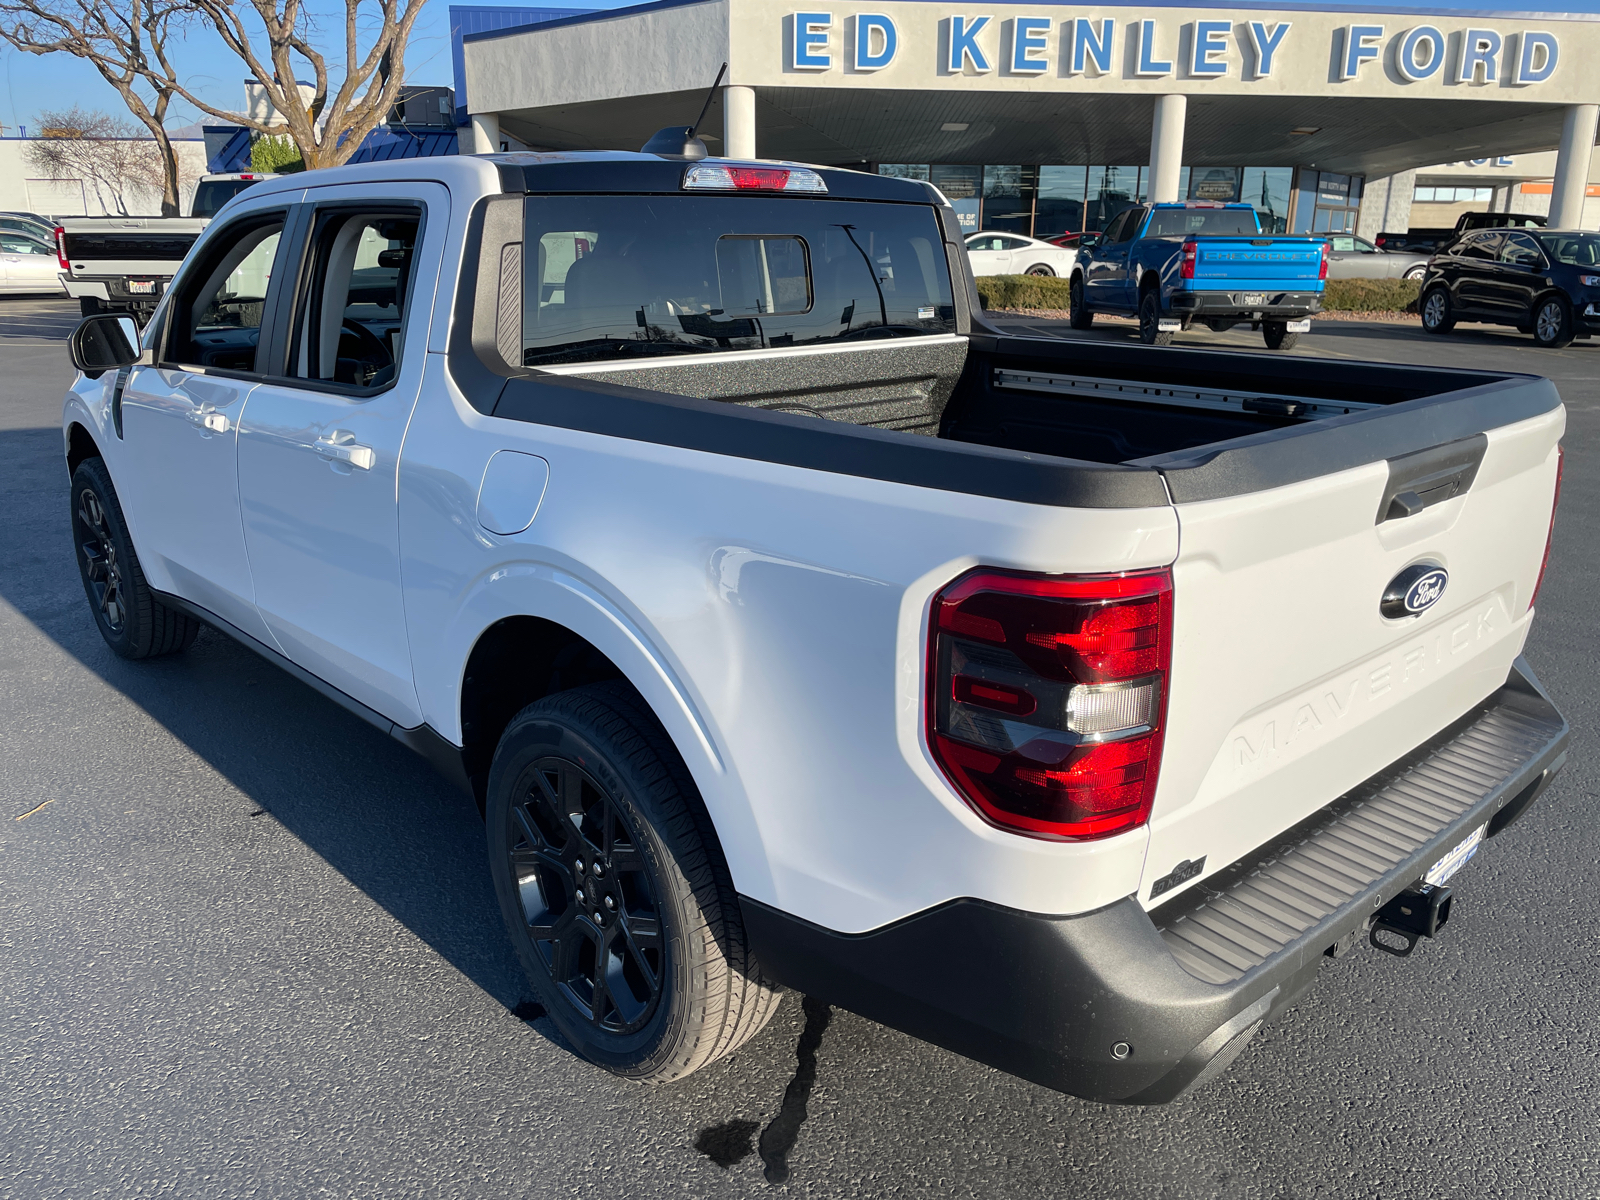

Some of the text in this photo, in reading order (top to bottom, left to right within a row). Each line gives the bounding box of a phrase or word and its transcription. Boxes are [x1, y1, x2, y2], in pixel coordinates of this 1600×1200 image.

[793, 11, 1560, 85] ED KENLEY FORD
[1205, 252, 1315, 261] CHEVROLET
[1413, 576, 1442, 608] Ford
[1232, 605, 1495, 770] MAVERICK
